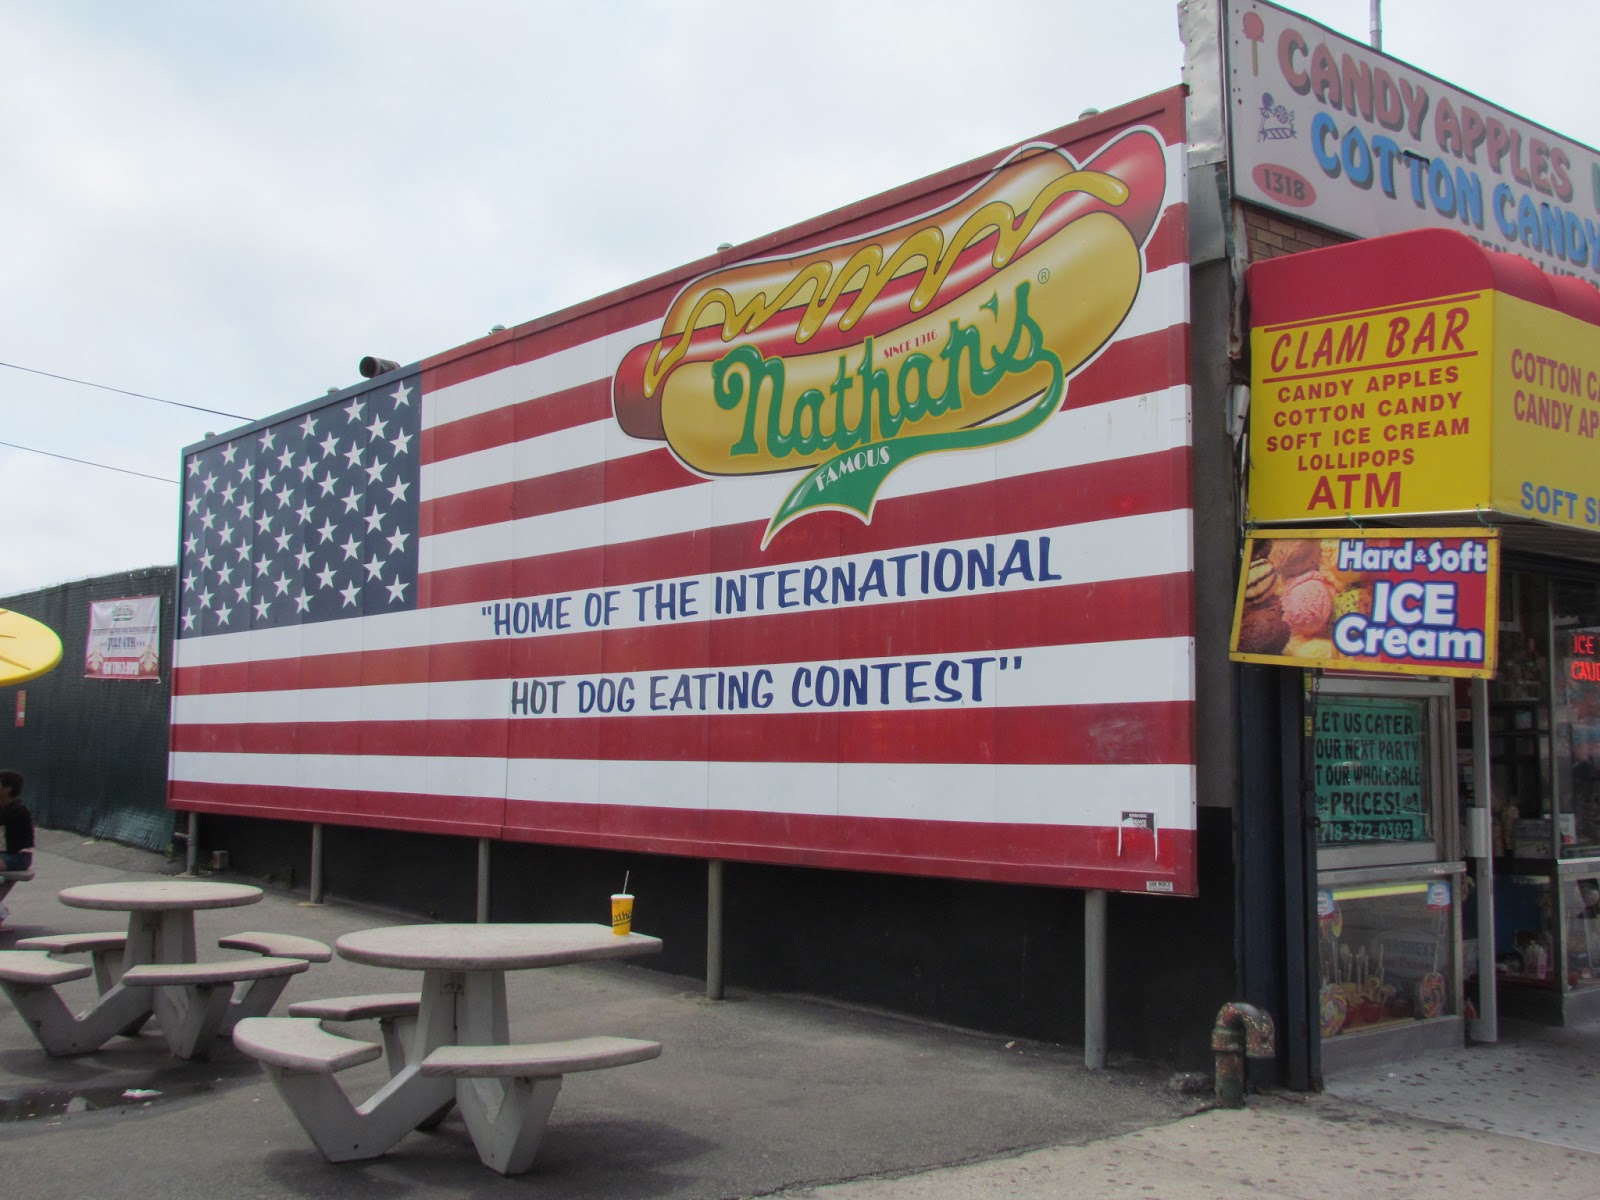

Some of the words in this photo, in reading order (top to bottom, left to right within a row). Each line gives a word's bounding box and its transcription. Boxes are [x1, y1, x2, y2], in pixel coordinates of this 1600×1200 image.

[1277, 29, 1429, 141] CANDY
[1434, 97, 1573, 203] APPLES
[1263, 167, 1305, 201] 1318
[1311, 112, 1484, 231] COTTON
[884, 341, 911, 359] SINCE
[1271, 322, 1369, 374] CLAM
[1386, 307, 1470, 359] BAR
[712, 279, 1045, 458] Nathan's
[1278, 379, 1353, 403] CANDY
[1367, 365, 1459, 393] APPLES
[1511, 348, 1581, 397] COTTON
[1587, 371, 1600, 402] C
[1274, 403, 1365, 427] COTTON
[1377, 391, 1462, 418] CANDY
[1513, 389, 1573, 432] CANDY
[1578, 407, 1600, 439] AP
[1266, 432, 1322, 452] SOFT
[1334, 427, 1371, 446] ICE
[1383, 417, 1469, 442] CREAM
[815, 445, 890, 493] FAMOUS
[1298, 448, 1415, 471] LOLLIPOPS
[1307, 471, 1401, 511] ATM
[1520, 481, 1578, 519] SOFT
[1585, 496, 1600, 524] S
[1338, 539, 1413, 571] Hard
[1426, 540, 1488, 573] Soft
[584, 590, 620, 628] OF
[633, 580, 699, 621] THE
[715, 536, 1062, 615] INTERNATIONAL
[1372, 581, 1456, 626] ICE
[1334, 613, 1485, 662] Cream
[1573, 635, 1594, 655] ICE
[511, 679, 566, 715] HOT
[577, 676, 635, 714] DOG
[648, 669, 774, 711] EATING
[1344, 712, 1361, 733] US
[1365, 713, 1414, 735] CATER
[1315, 739, 1342, 760] OUR
[1345, 739, 1375, 760] NEXT
[1378, 740, 1420, 761] PARTY
[1326, 765, 1350, 786] OUR
[1353, 765, 1421, 786] WHOLESALE
[1330, 792, 1401, 816] PRICES!
